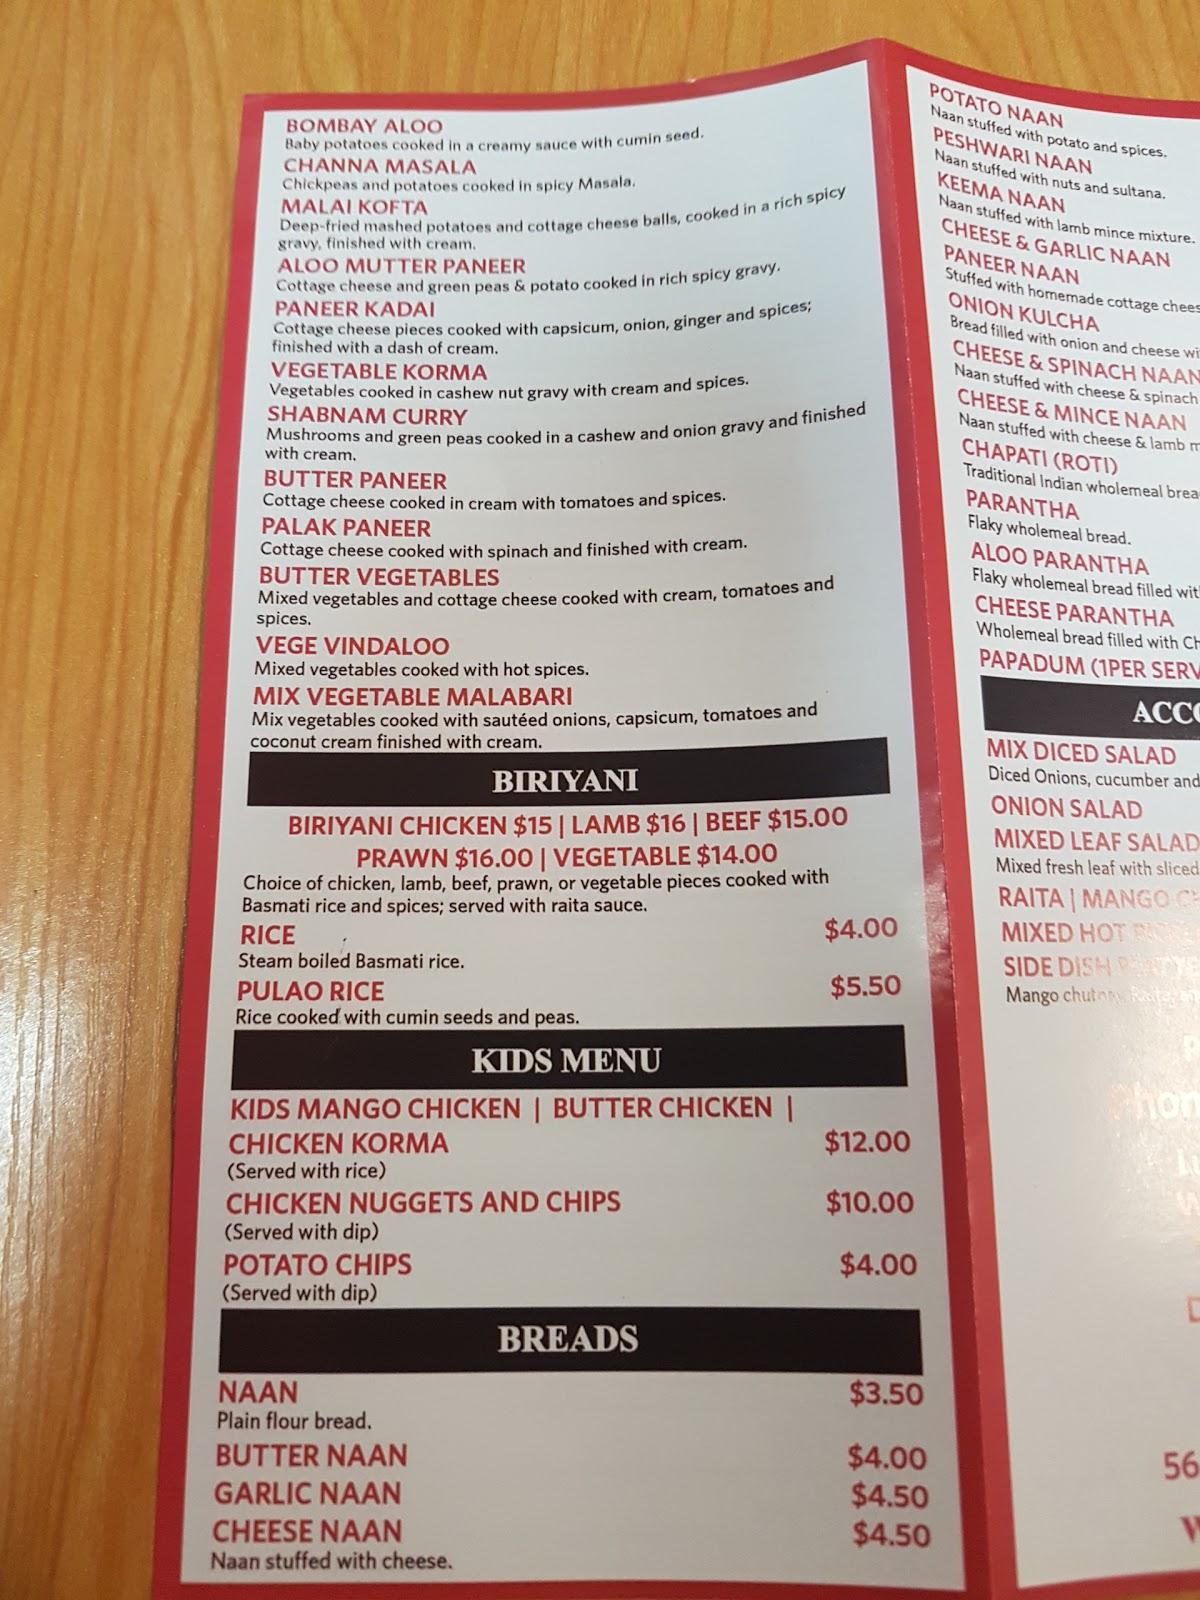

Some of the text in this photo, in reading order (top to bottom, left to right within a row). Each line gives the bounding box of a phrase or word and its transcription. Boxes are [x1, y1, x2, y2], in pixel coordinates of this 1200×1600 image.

[929, 82, 1063, 128] POTATO NAAN
[287, 118, 442, 134] BOMBAY ALOO
[930, 103, 1167, 157] Naan stuffed with potato and spices.
[285, 126, 704, 154] Baby potatoes cooked in a creamy sauce with cumin seed.
[933, 126, 1092, 174] PESHWARI NAAN
[284, 157, 476, 175] CHANNA MASALA
[937, 170, 1065, 213] KEEMA NAAN
[281, 198, 427, 215] MALAI KOFTA
[941, 217, 1170, 267] CHEESE & GARLIC NAAN
[278, 257, 525, 274] ALOO MUTTER PANEER
[944, 243, 1079, 285] PANEER NAAN
[276, 262, 780, 295] Cottage cheese and green peas & potato cooked in rich spicy gravy.
[275, 300, 434, 317] PANEER KADAI
[948, 291, 1099, 332] ONION KULCHA
[271, 361, 487, 380] VEGETABLE KORMA
[267, 405, 467, 425] SHABNAM CURRY
[264, 445, 356, 461] with cream.
[962, 437, 1117, 475] CHAPATI (ROTI)
[264, 469, 446, 489] BUTTER PANEER
[966, 488, 1079, 520] PARANTHA
[262, 516, 430, 537] PALAK PANEER
[968, 513, 1131, 545] Flaky wholemeal bread.
[971, 541, 1149, 575] ALOO PARANTHA
[260, 566, 499, 586] BUTTER VEGETABLES
[256, 611, 311, 628] spices.
[975, 594, 1174, 627] CHEESE PARANTHA
[255, 635, 449, 655] VEGE VINDALOO
[254, 660, 588, 679] Mixed vegetables cooked with hot spices.
[253, 686, 571, 706] MIX VEGETABLE MALABARI
[987, 737, 1176, 765] MIX DICED SALAD
[492, 768, 638, 792] BIRIYANI
[991, 794, 1142, 819] ONION SALAD
[994, 827, 1200, 852] MIXED LEAF SALAD
[241, 924, 295, 945] RICE
[825, 916, 897, 941] $4.00
[238, 951, 464, 969] Steam boiled Basmati rice.
[237, 980, 384, 1001] PULAO RICE
[831, 973, 901, 999] $5.50
[236, 1007, 579, 1028] Rice cooked with cumin seeds and peas.
[471, 1047, 662, 1073] KIDS MENU
[229, 1132, 448, 1154] CHICKEN KORMA
[825, 1129, 910, 1156] $12.00
[227, 1160, 386, 1181] (Served with rice)
[226, 1190, 620, 1215] CHICKEN NUGGETS AND CHIPS
[827, 1189, 913, 1216] $10.00
[224, 1221, 378, 1243] (Served with dip)
[224, 1253, 411, 1276] POTATO CHIPS
[841, 1251, 917, 1279] $4.00
[498, 1324, 638, 1352] BREADS
[219, 1380, 297, 1403] NAAN
[850, 1380, 923, 1408] $3.50
[217, 1410, 371, 1430] Plain flour bread.
[216, 1443, 406, 1467] BUTTER NAAN
[848, 1444, 927, 1471] $4.00
[214, 1481, 400, 1505] GARLIC NAAN
[852, 1482, 928, 1510] $4.50
[212, 1519, 401, 1543] CHEESE NAAN
[854, 1520, 930, 1549] $4.50
[211, 1550, 452, 1570] Naan stuffed with cheese.
